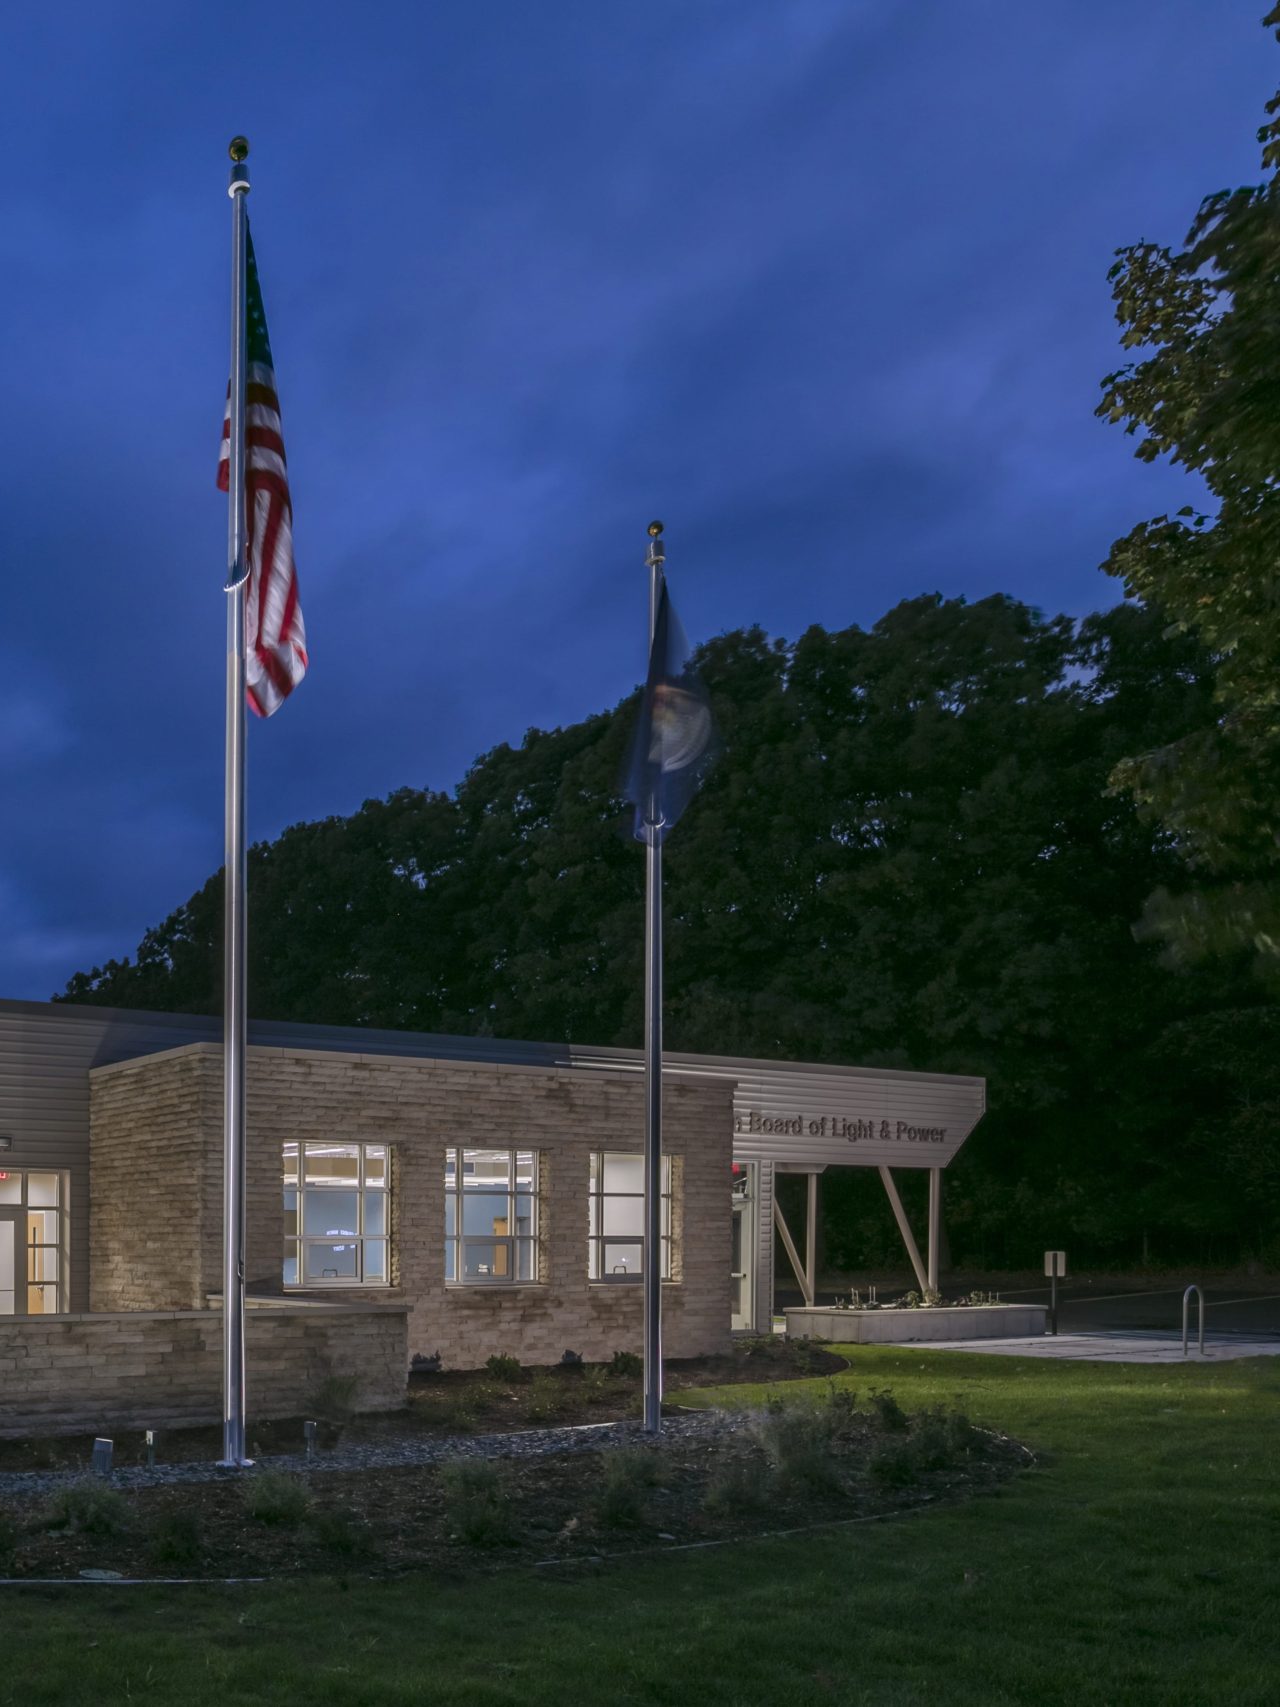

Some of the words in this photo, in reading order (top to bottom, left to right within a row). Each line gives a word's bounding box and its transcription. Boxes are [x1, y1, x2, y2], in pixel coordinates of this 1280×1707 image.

[749, 1112, 803, 1136] Board
[809, 1116, 827, 1137] of
[831, 1117, 874, 1142] Light
[879, 1119, 891, 1140] &
[896, 1120, 948, 1143] Power
